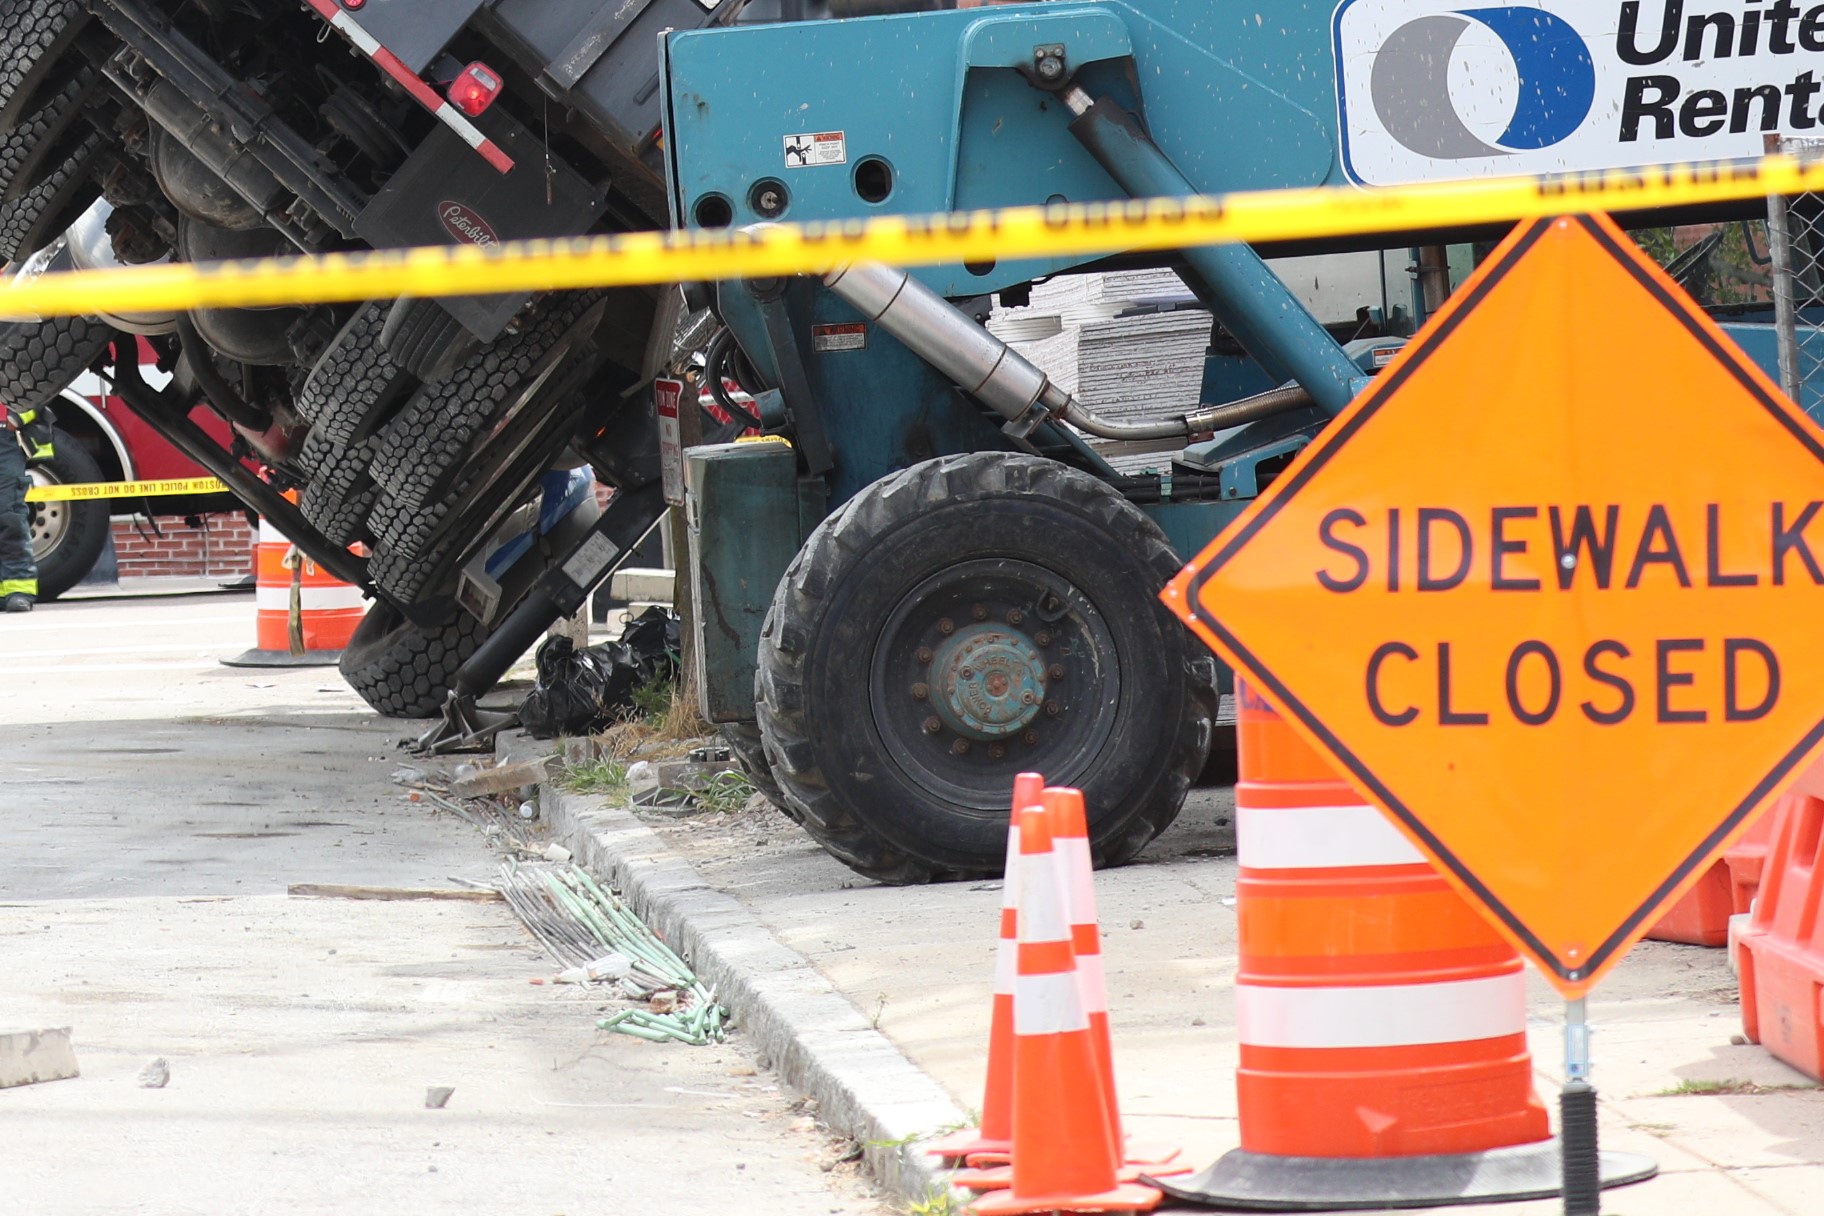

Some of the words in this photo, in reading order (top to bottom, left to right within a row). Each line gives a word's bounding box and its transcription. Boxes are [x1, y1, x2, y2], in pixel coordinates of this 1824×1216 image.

[1618, 70, 1824, 143] Rent
[442, 205, 497, 249] Peterbilt
[70, 487, 100, 496] CROSS
[103, 486, 120, 495] NOT
[123, 485, 135, 494] DO
[139, 484, 156, 493] LINE
[159, 482, 189, 492] POLICE
[1314, 500, 1824, 595] SIDEWALK
[1364, 638, 1781, 728] CLOSED
